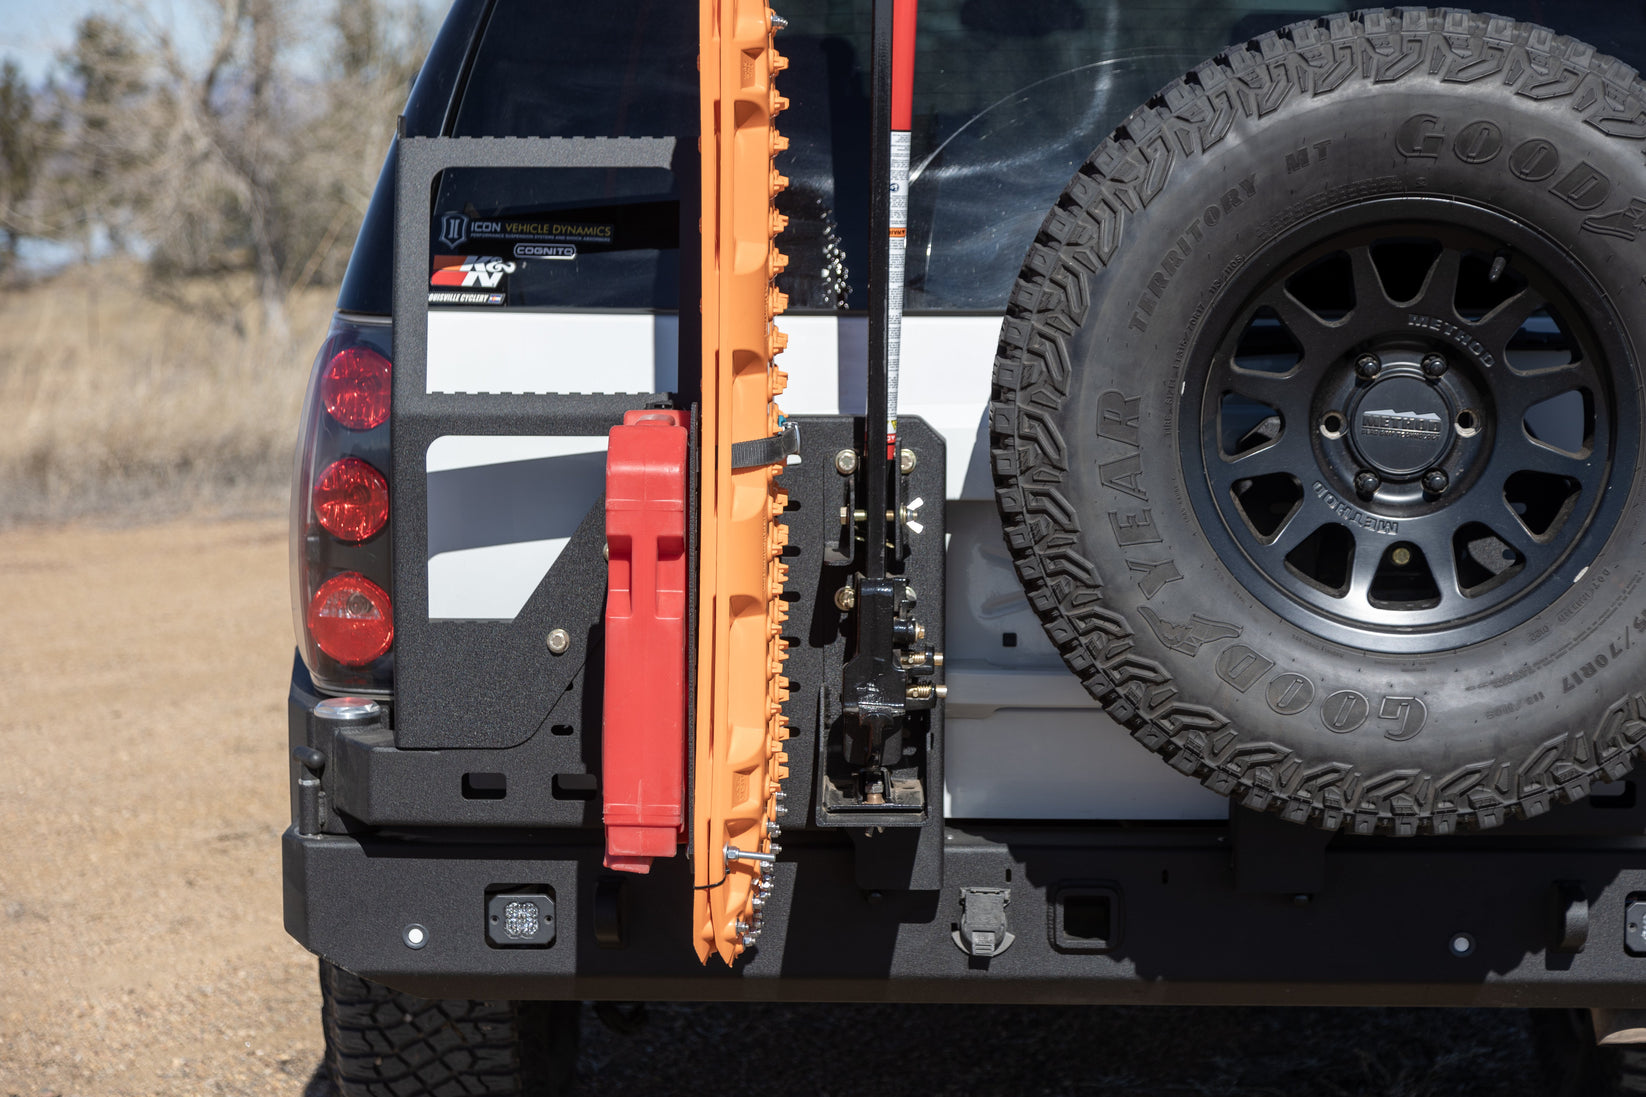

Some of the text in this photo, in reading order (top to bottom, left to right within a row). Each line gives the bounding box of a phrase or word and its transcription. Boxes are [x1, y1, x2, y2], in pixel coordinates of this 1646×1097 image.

[470, 221, 612, 237] ICON VEHICLE DYNAMICS
[1128, 172, 1258, 333] TERRITORY
[1284, 139, 1332, 175] MT
[516, 246, 574, 257] COGNITO
[459, 255, 517, 289] K&N
[428, 293, 489, 303] OUISVILLE CYCLERY
[1407, 313, 1496, 368] METHOD
[1312, 480, 1399, 536] METHOD
